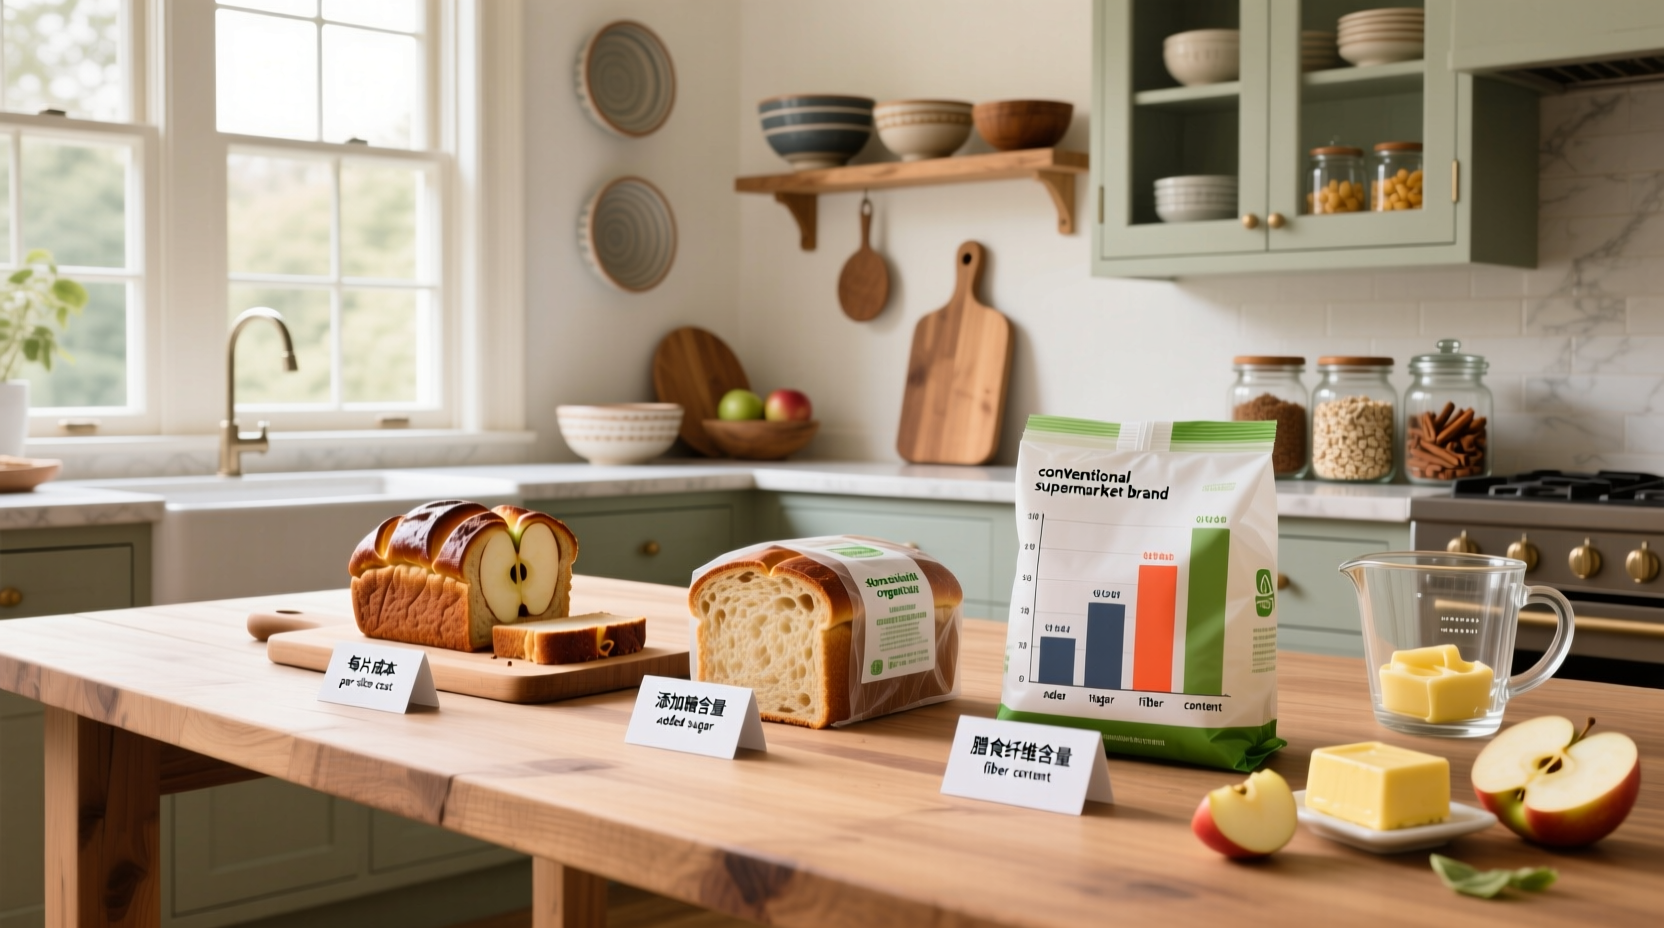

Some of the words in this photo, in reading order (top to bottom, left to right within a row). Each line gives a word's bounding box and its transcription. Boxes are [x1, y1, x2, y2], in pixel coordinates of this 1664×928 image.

[1038, 468, 1131, 484] conventional
[1034, 481, 1124, 497] supermarket
[1127, 484, 1170, 500] brand
[1183, 701, 1223, 713] content
[983, 760, 1010, 777] fiber
